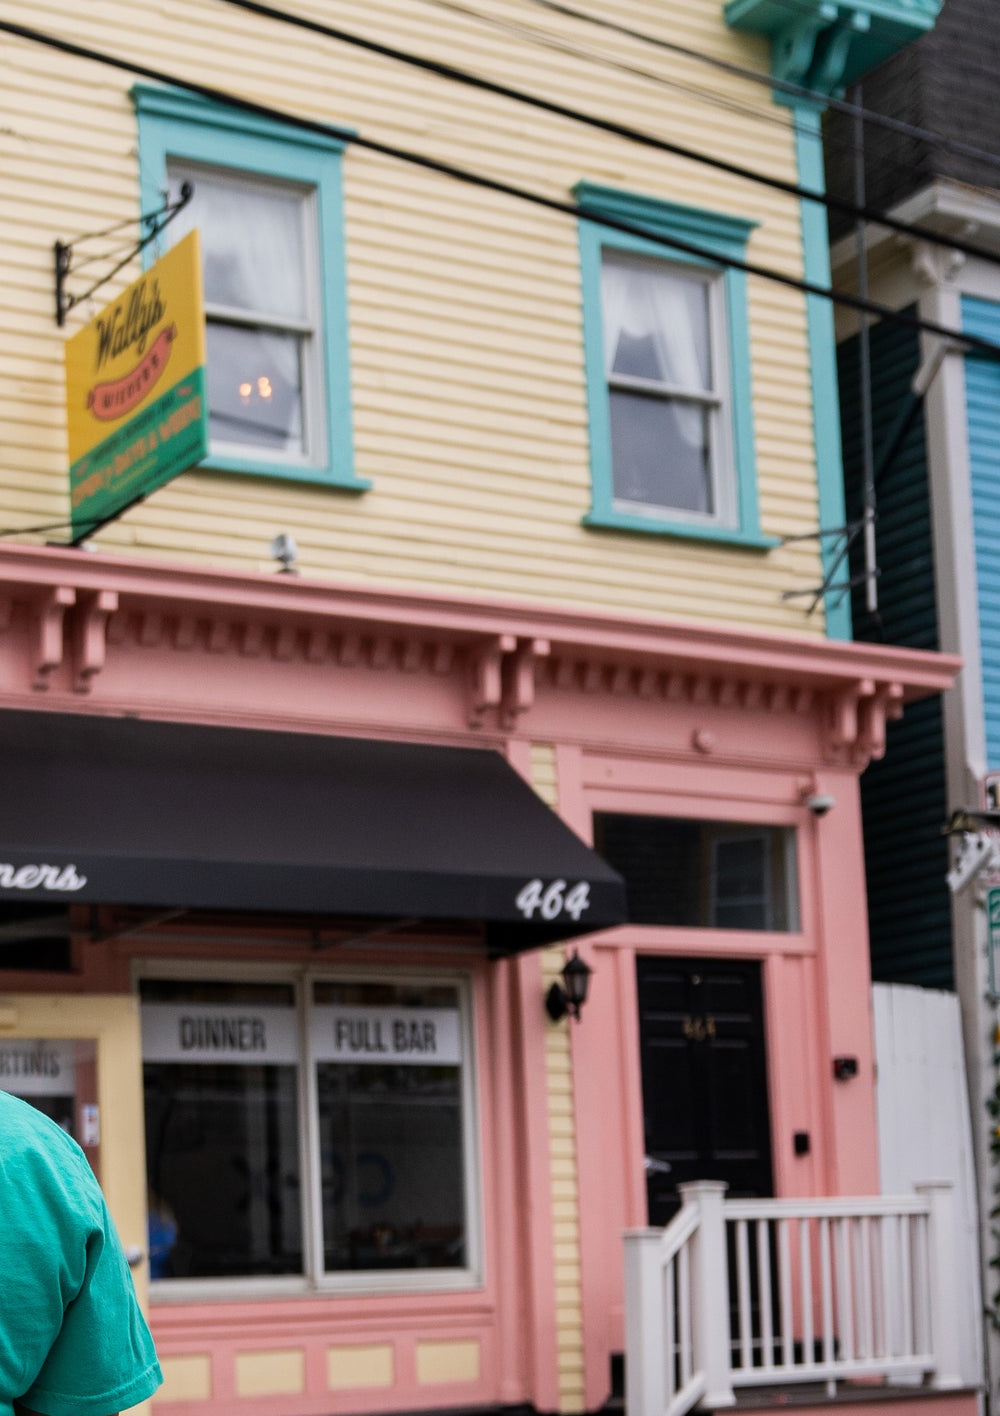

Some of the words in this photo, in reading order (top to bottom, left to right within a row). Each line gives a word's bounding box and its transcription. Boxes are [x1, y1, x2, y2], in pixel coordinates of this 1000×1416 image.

[94, 278, 166, 373] Wally's
[516, 879, 591, 921] 464
[179, 1016, 267, 1051] DINNER
[334, 1018, 388, 1052] FULL
[392, 1019, 437, 1052] BAR
